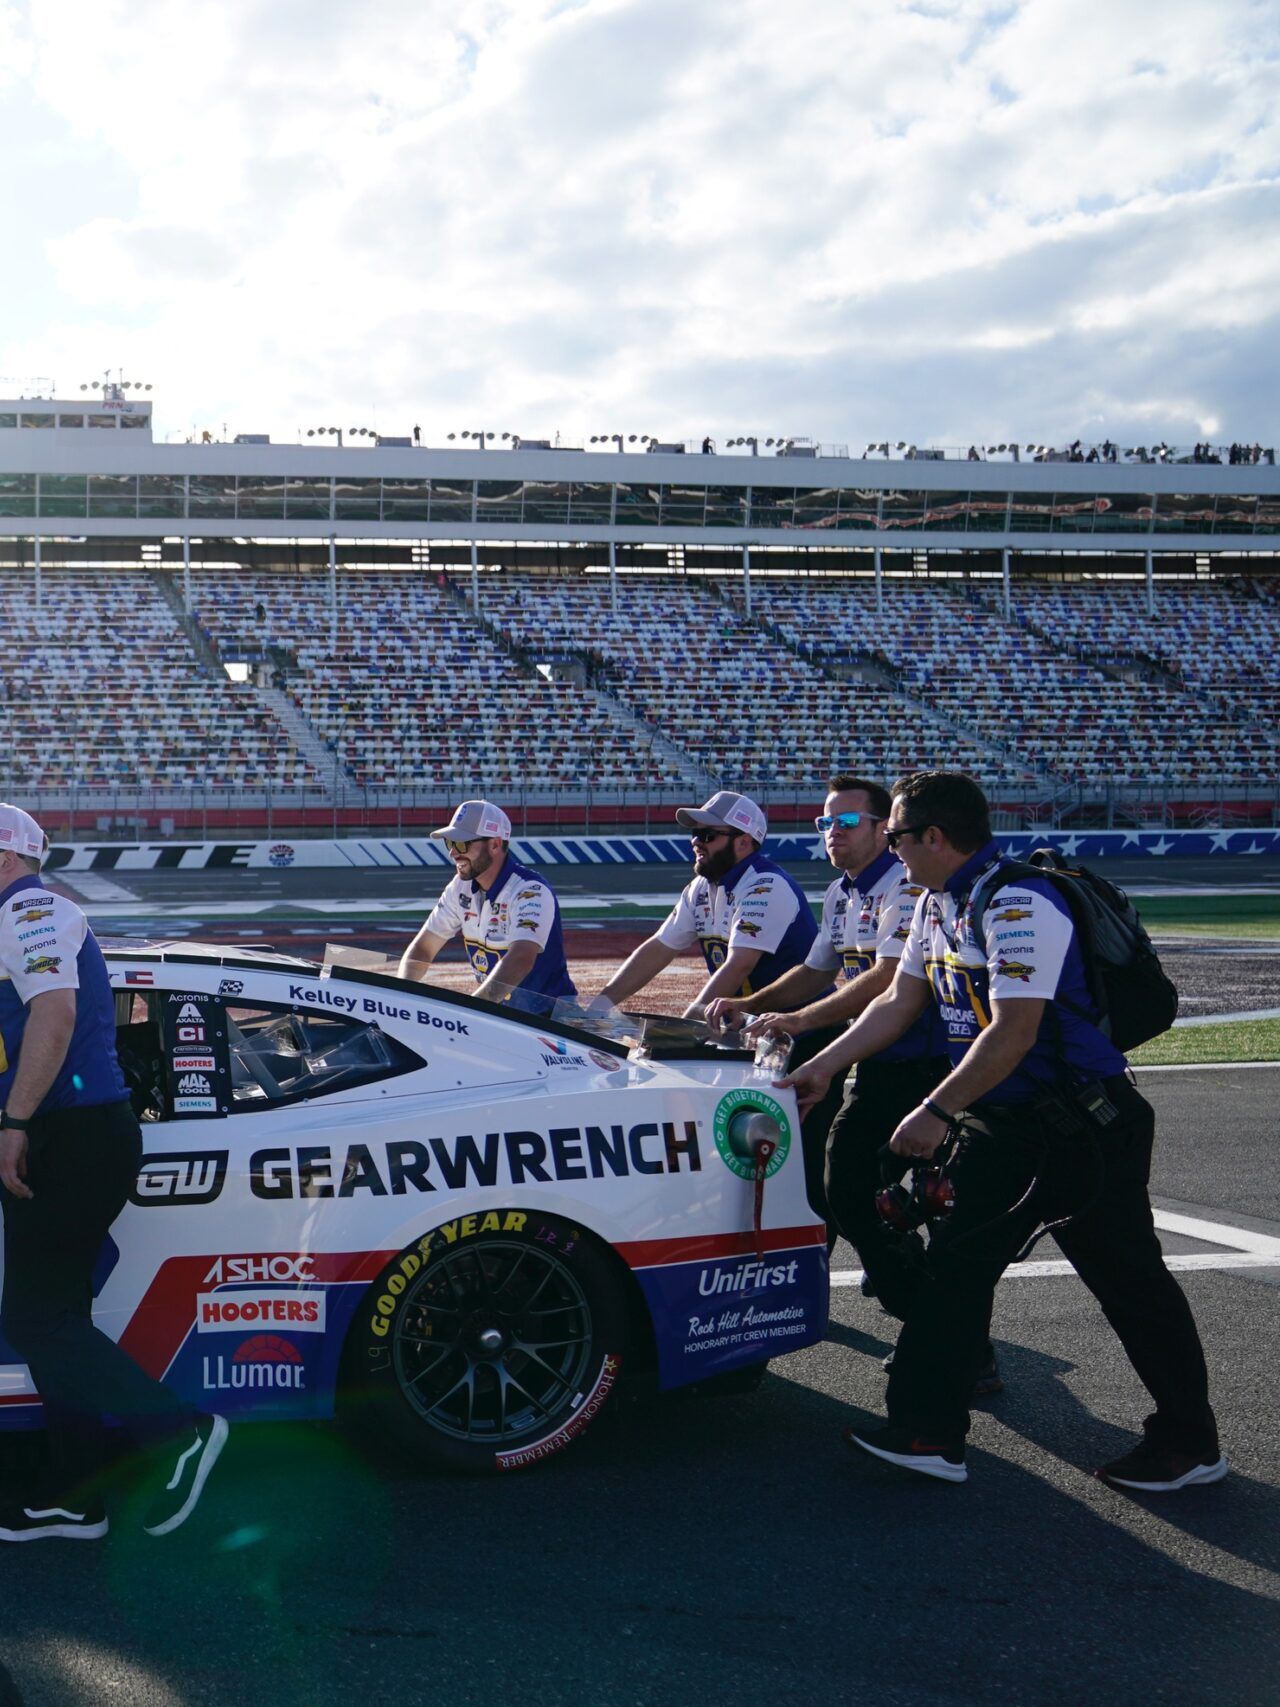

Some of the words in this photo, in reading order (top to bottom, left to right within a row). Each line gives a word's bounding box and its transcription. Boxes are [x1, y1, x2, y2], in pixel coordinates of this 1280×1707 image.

[22, 898, 53, 908] NASCAR
[18, 926, 56, 942] SIEMENS
[996, 930, 1035, 941] SIEMENS
[23, 938, 57, 956] Acronis
[997, 947, 1035, 955] Acronis
[168, 994, 209, 1003] Acronis
[289, 985, 358, 1013] Kelley
[363, 998, 411, 1021] Blue
[417, 1010, 470, 1036] Book
[178, 1027, 204, 1041] CI
[175, 1060, 213, 1068] HOOTERS
[540, 1053, 588, 1067] VALVOLINE
[178, 1073, 211, 1089] MAC
[716, 1105, 728, 1124] GET
[249, 1121, 703, 1200] GEARWRENCH
[724, 1152, 739, 1171] GET
[741, 1146, 787, 1179] BIOHANOL
[136, 1160, 217, 1197] GW
[371, 1211, 528, 1337] GOODYEAR
[698, 1260, 799, 1296] UniFirst
[202, 1300, 319, 1323] HOOTERS
[688, 1316, 715, 1338] Rock
[717, 1311, 741, 1333] Hill
[741, 1305, 805, 1327] Automotive
[684, 1335, 730, 1354] HONORARY
[730, 1333, 743, 1344] PIT
[743, 1328, 768, 1341] CREW
[769, 1324, 807, 1337] MEMBER
[203, 1355, 305, 1390] LLumar
[580, 1374, 615, 1421] HONOR
[498, 1430, 572, 1469] REMEMBER
